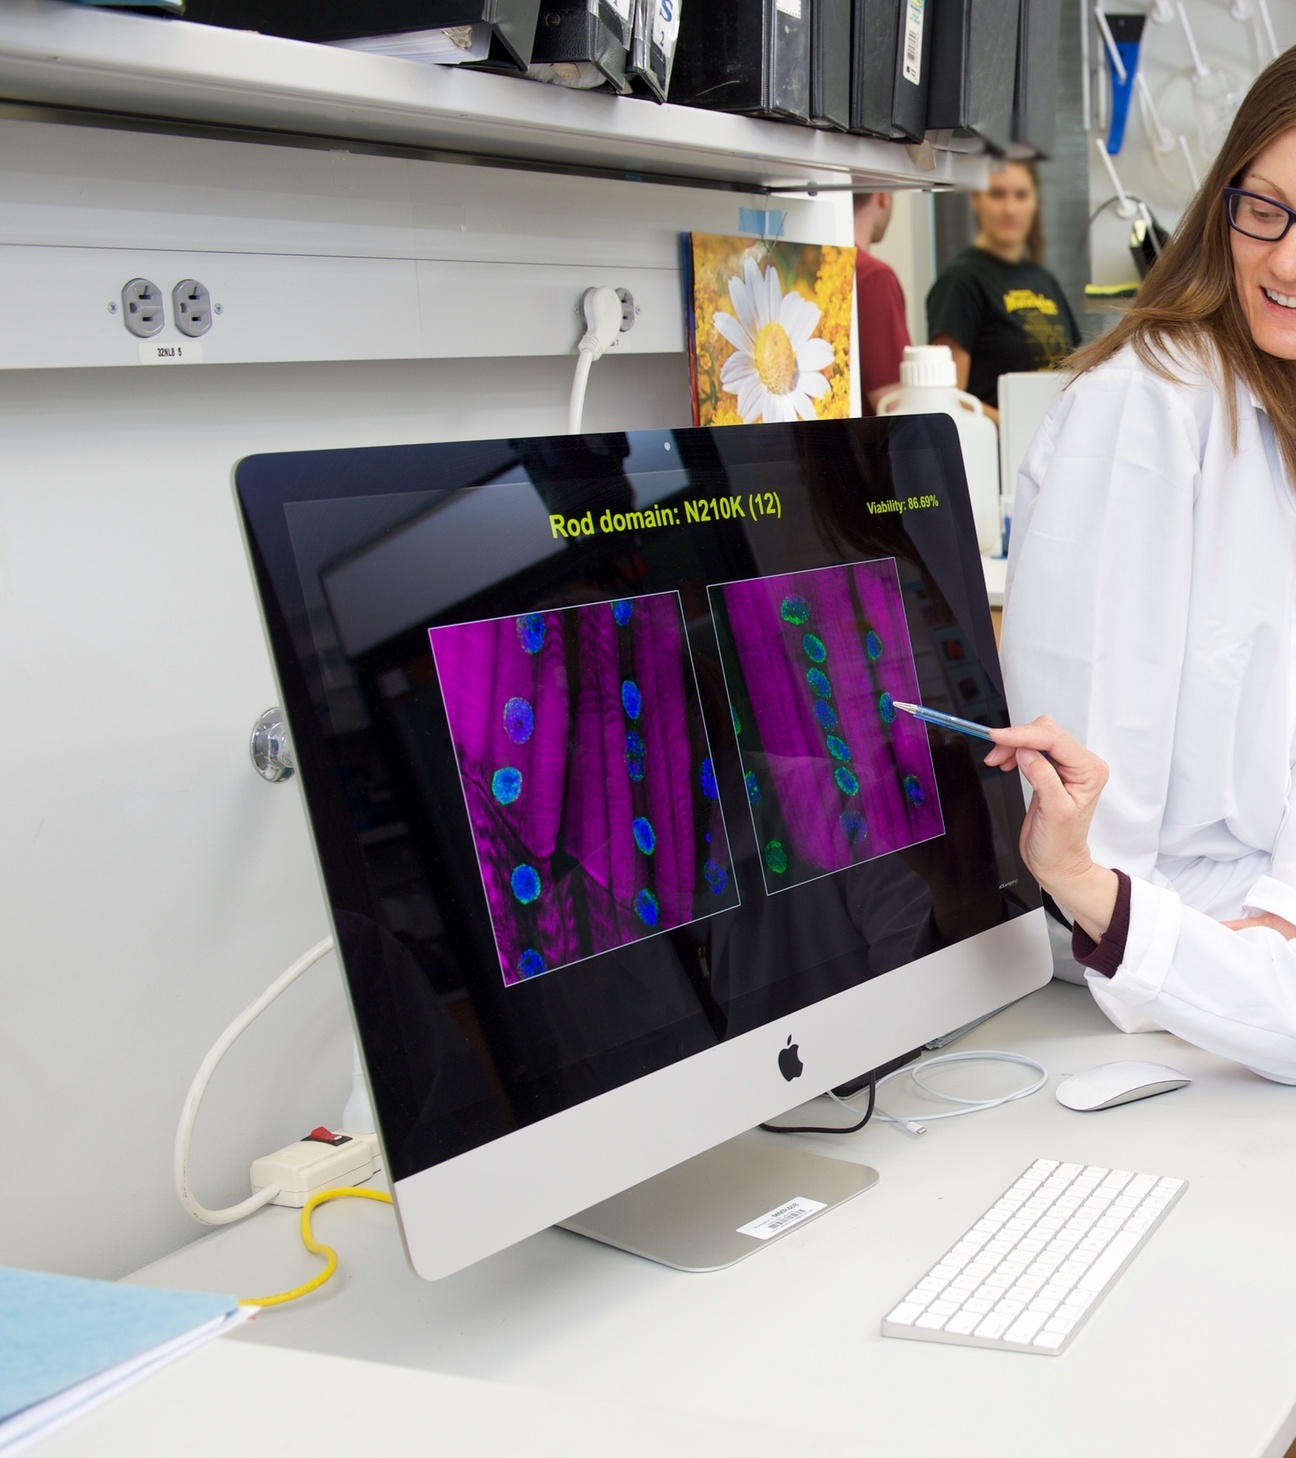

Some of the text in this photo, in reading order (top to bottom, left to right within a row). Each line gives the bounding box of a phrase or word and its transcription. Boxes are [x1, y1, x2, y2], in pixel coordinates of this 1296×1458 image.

[549, 491, 782, 539] Rod domain: N210K (12)
[866, 494, 939, 515] Viability: 86.69%
